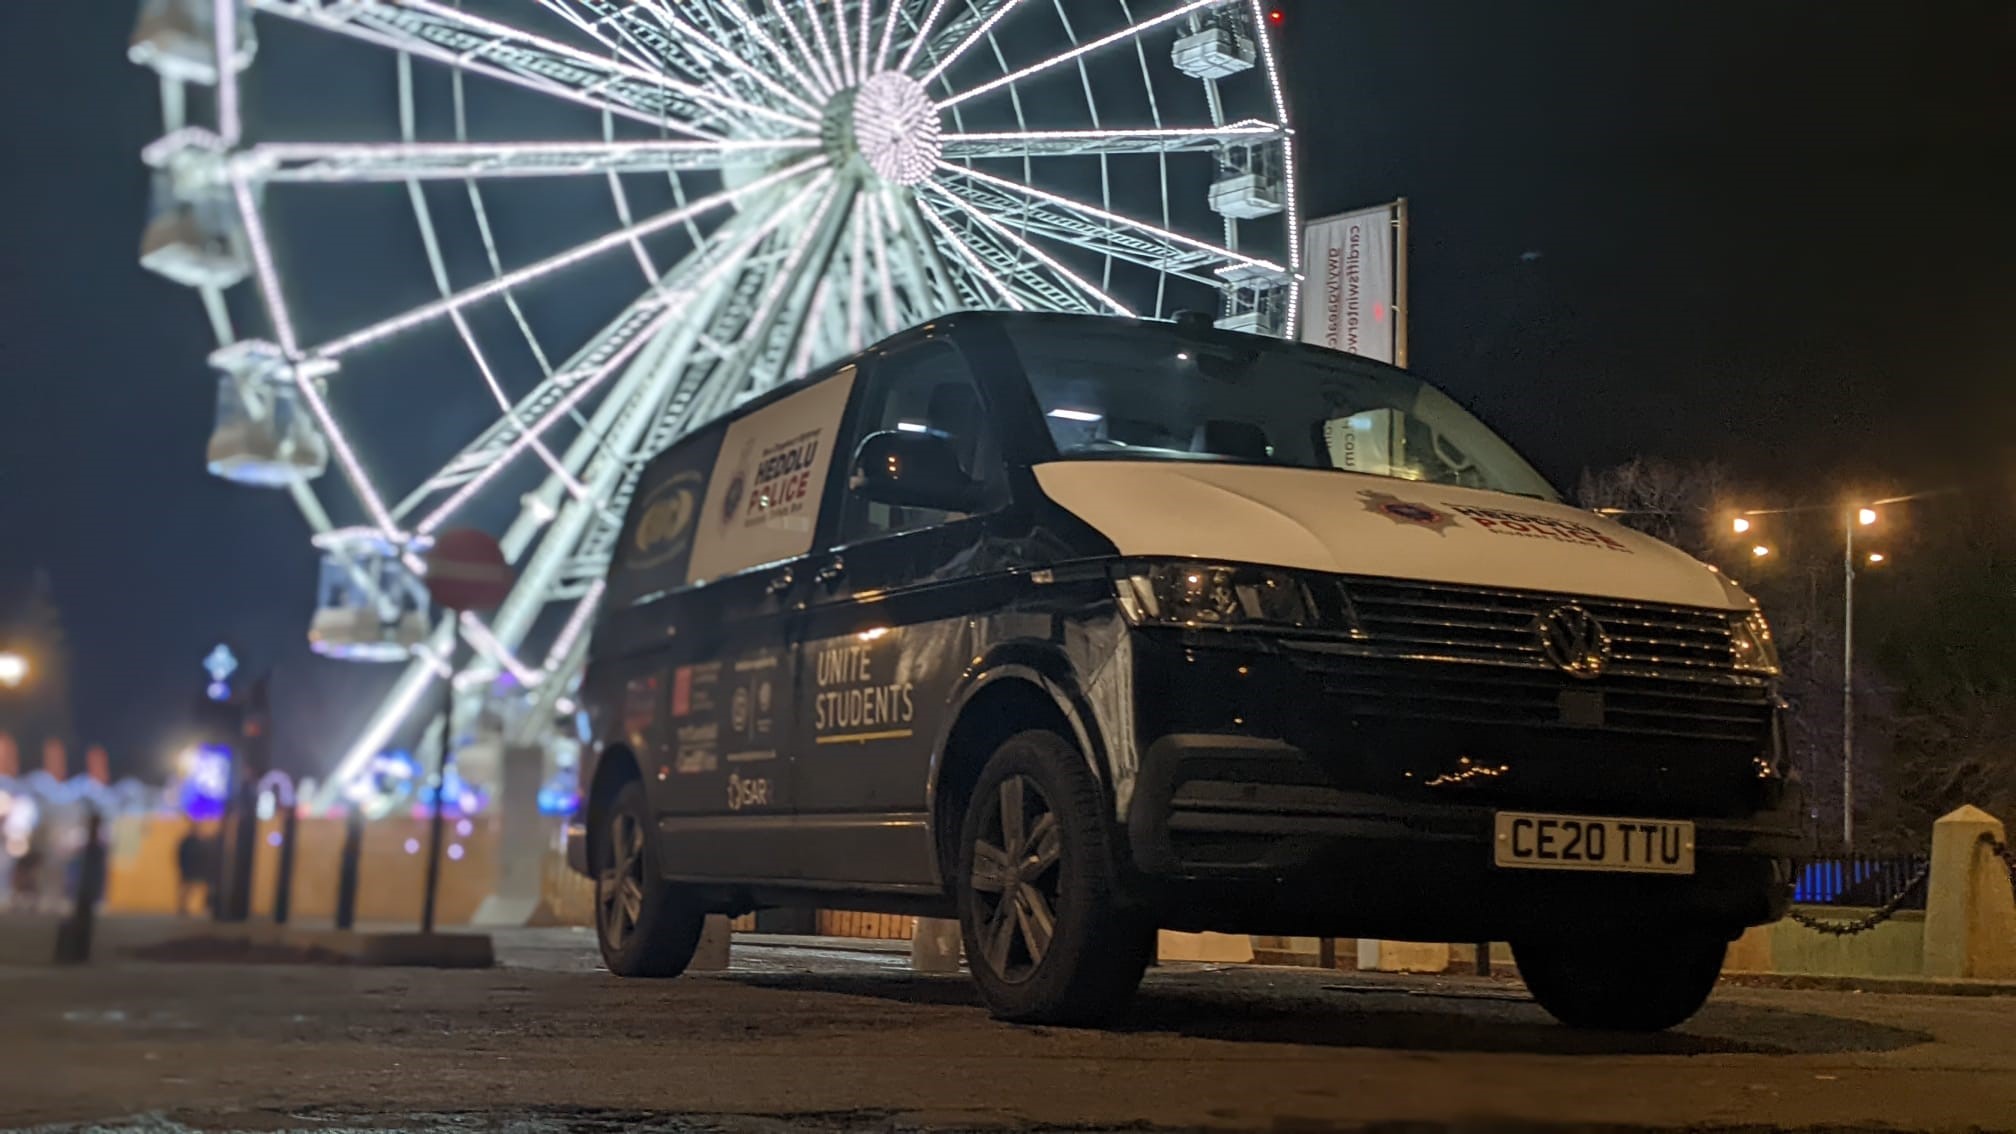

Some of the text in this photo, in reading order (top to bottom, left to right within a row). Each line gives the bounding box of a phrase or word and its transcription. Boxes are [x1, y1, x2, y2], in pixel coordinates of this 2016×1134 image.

[755, 440, 819, 486] HEDDLU
[747, 470, 810, 515] POLICE
[1470, 516, 1625, 548] POLICE
[817, 645, 872, 686] UNITE
[815, 683, 913, 730] STUDENTS
[1512, 818, 1680, 864] CE20 TTU
